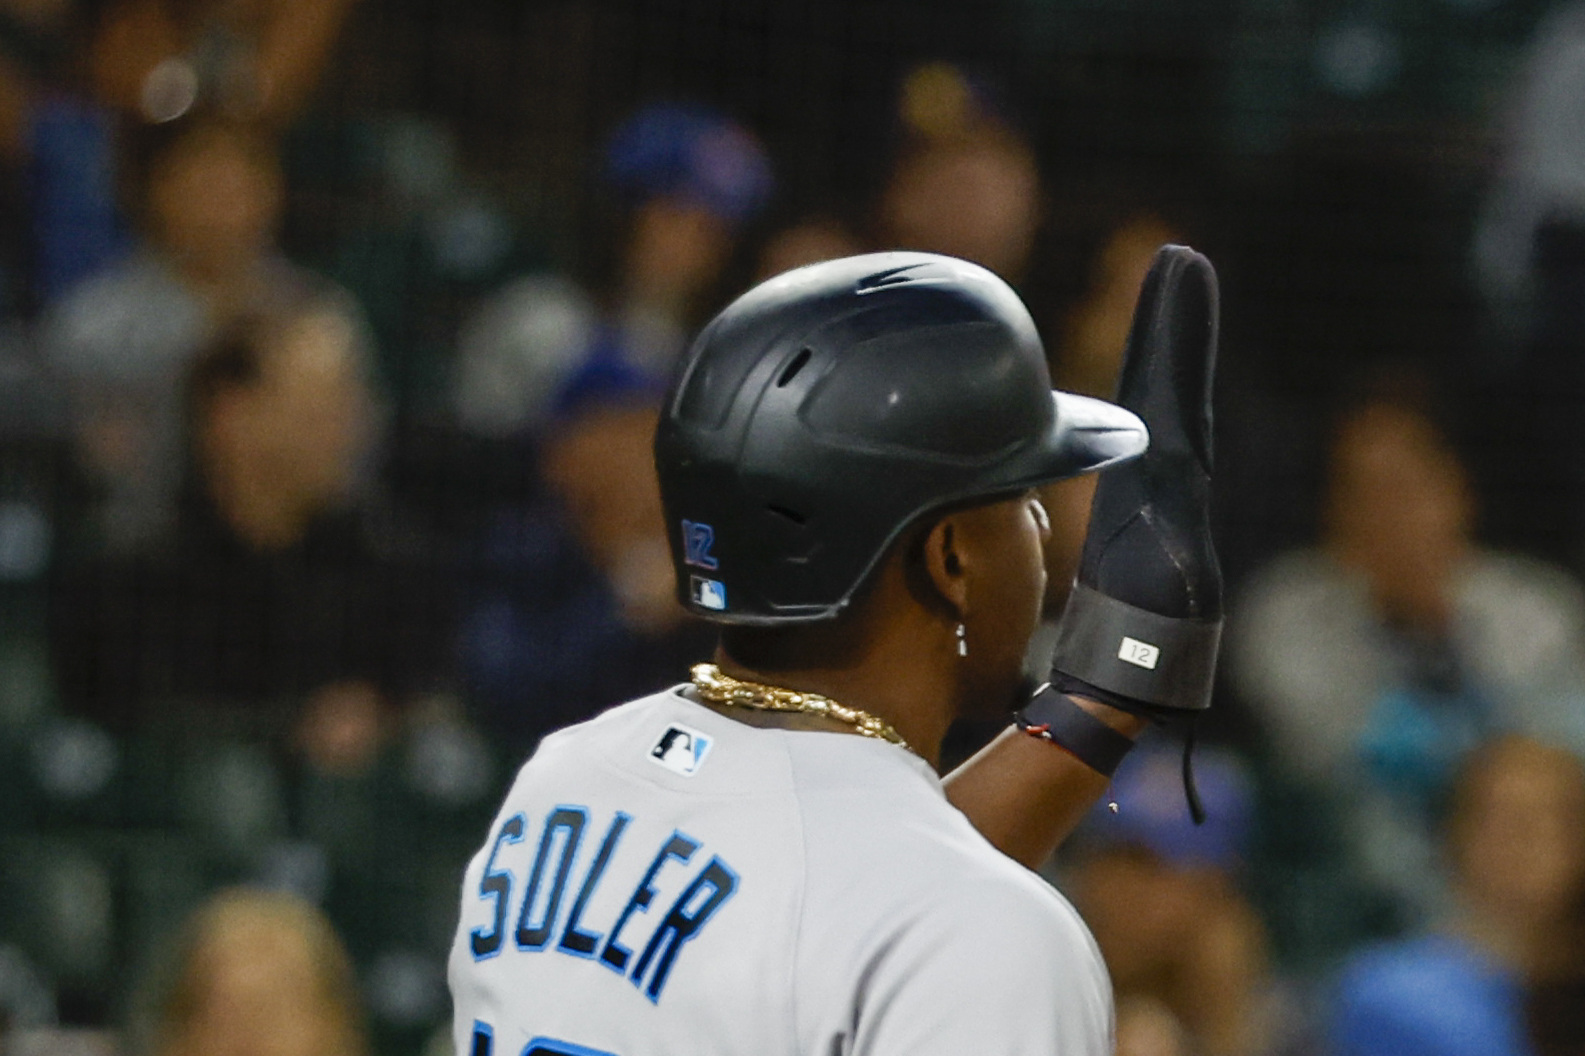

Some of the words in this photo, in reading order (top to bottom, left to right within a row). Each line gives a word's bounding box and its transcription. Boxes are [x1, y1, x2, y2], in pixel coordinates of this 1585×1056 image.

[681, 518, 719, 571] 12
[1130, 643, 1153, 664] 12
[469, 804, 741, 1006] SOLER
